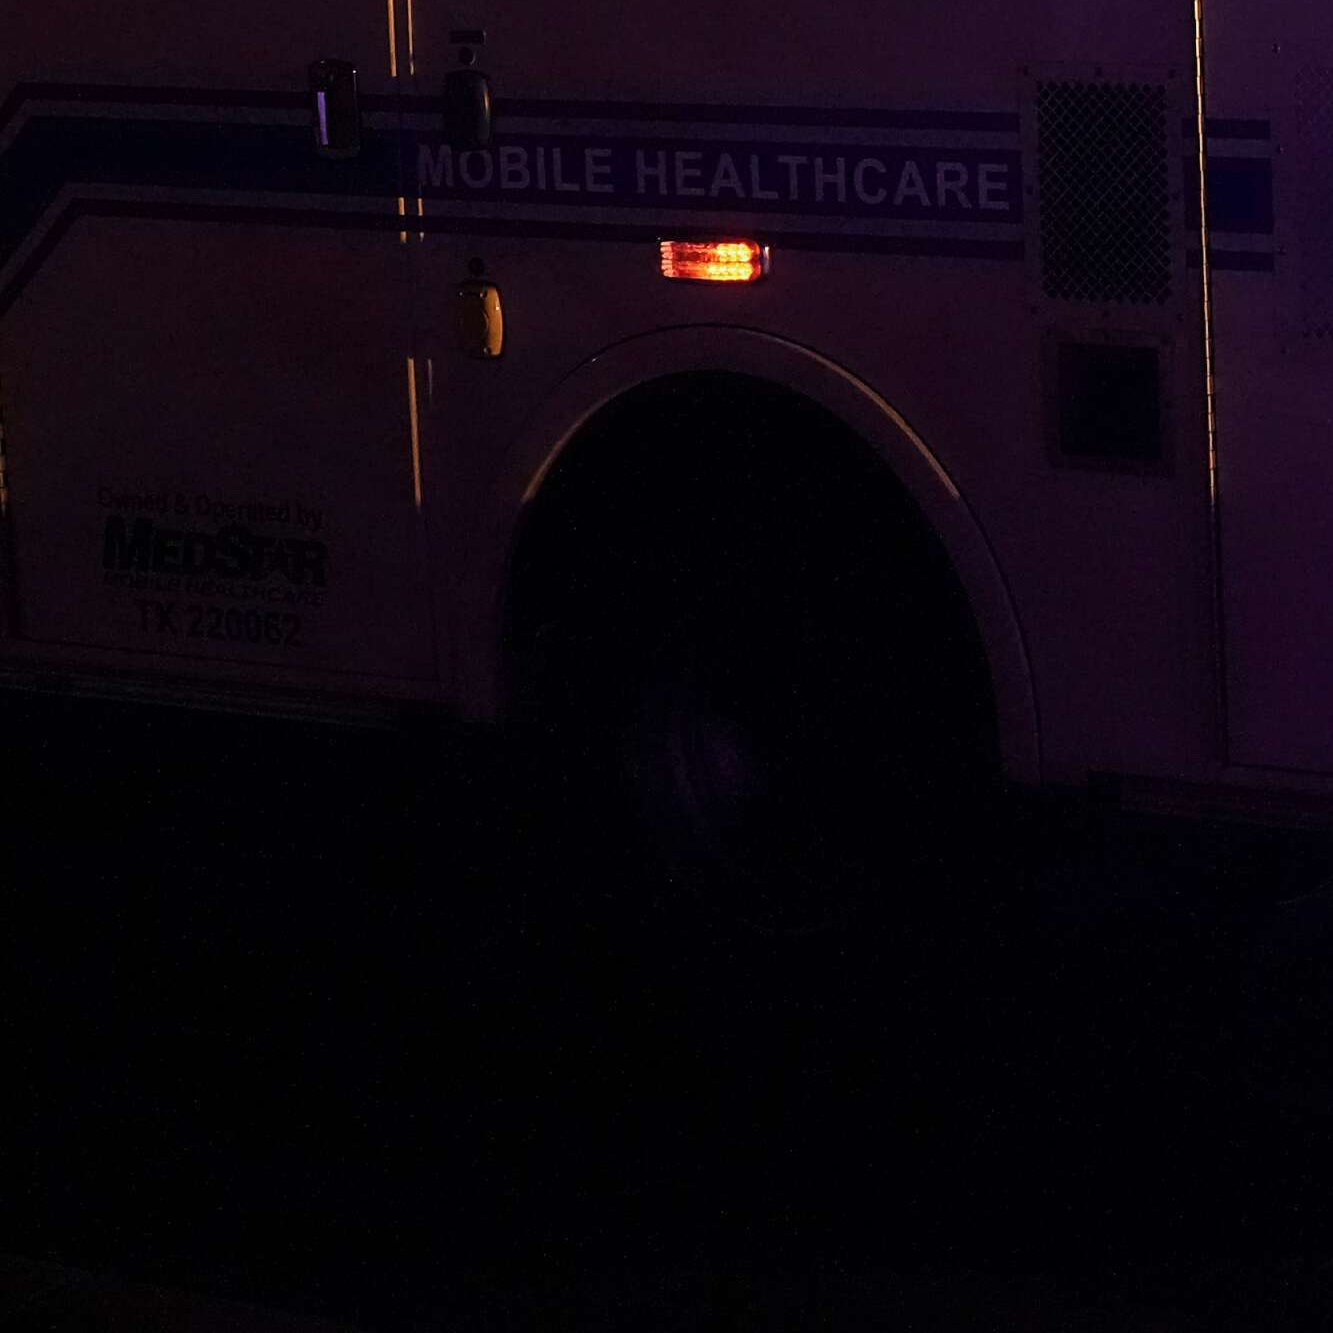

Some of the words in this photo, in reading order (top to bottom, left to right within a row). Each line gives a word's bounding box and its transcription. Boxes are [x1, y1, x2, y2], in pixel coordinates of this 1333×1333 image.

[415, 141, 614, 197] MOBILE
[635, 150, 1010, 211] HEALTHCARE
[137, 599, 177, 635] TX
